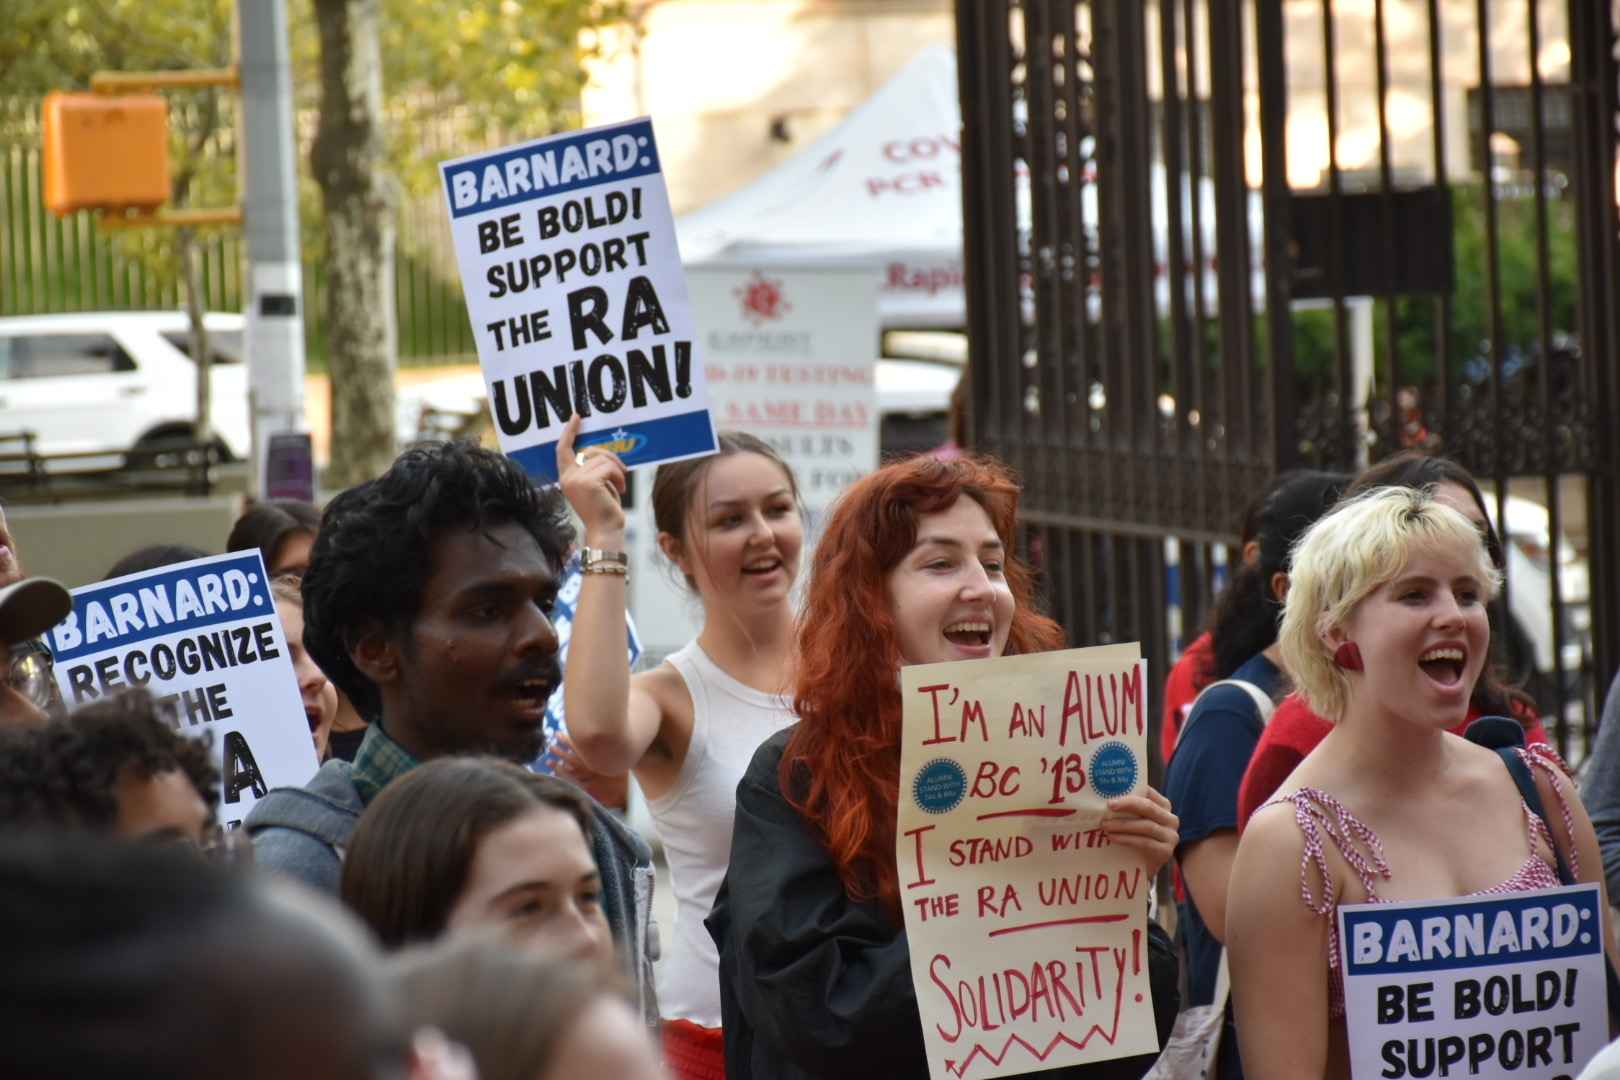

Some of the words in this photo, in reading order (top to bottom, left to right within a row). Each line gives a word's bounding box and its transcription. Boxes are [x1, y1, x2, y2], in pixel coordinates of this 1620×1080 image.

[451, 133, 651, 210] BARNARD:
[477, 213, 525, 255] BE
[537, 187, 643, 241] BOLD!
[486, 231, 650, 299] SUPPORT
[886, 260, 962, 295] Rapi
[487, 308, 553, 352] THE
[567, 275, 671, 351] RA
[491, 340, 693, 437] UNION!
[52, 568, 264, 652] BARNARD:
[66, 621, 280, 704] RECOGNIZE
[156, 682, 234, 730] THE
[917, 683, 988, 746] I'M
[1009, 702, 1045, 738] AN
[1059, 663, 1143, 746] ALUM
[919, 784, 942, 794] STAND
[943, 781, 961, 789] WITH
[926, 774, 953, 783] ALUMNI
[970, 761, 1020, 797] BC
[1040, 753, 1086, 804] '13
[1094, 768, 1116, 777] STAND
[1117, 766, 1133, 774] WITH
[1101, 758, 1126, 767] ALUMNI
[904, 825, 936, 889] I
[949, 836, 1033, 866] STAND
[914, 893, 959, 922] THE
[977, 884, 1022, 918] RA
[1039, 867, 1141, 906] UNION
[1353, 903, 1592, 965] BARNARD:
[1377, 982, 1435, 1025] BE
[1454, 968, 1578, 1020] BOLD!
[1381, 1022, 1580, 1080] SUPPORT
